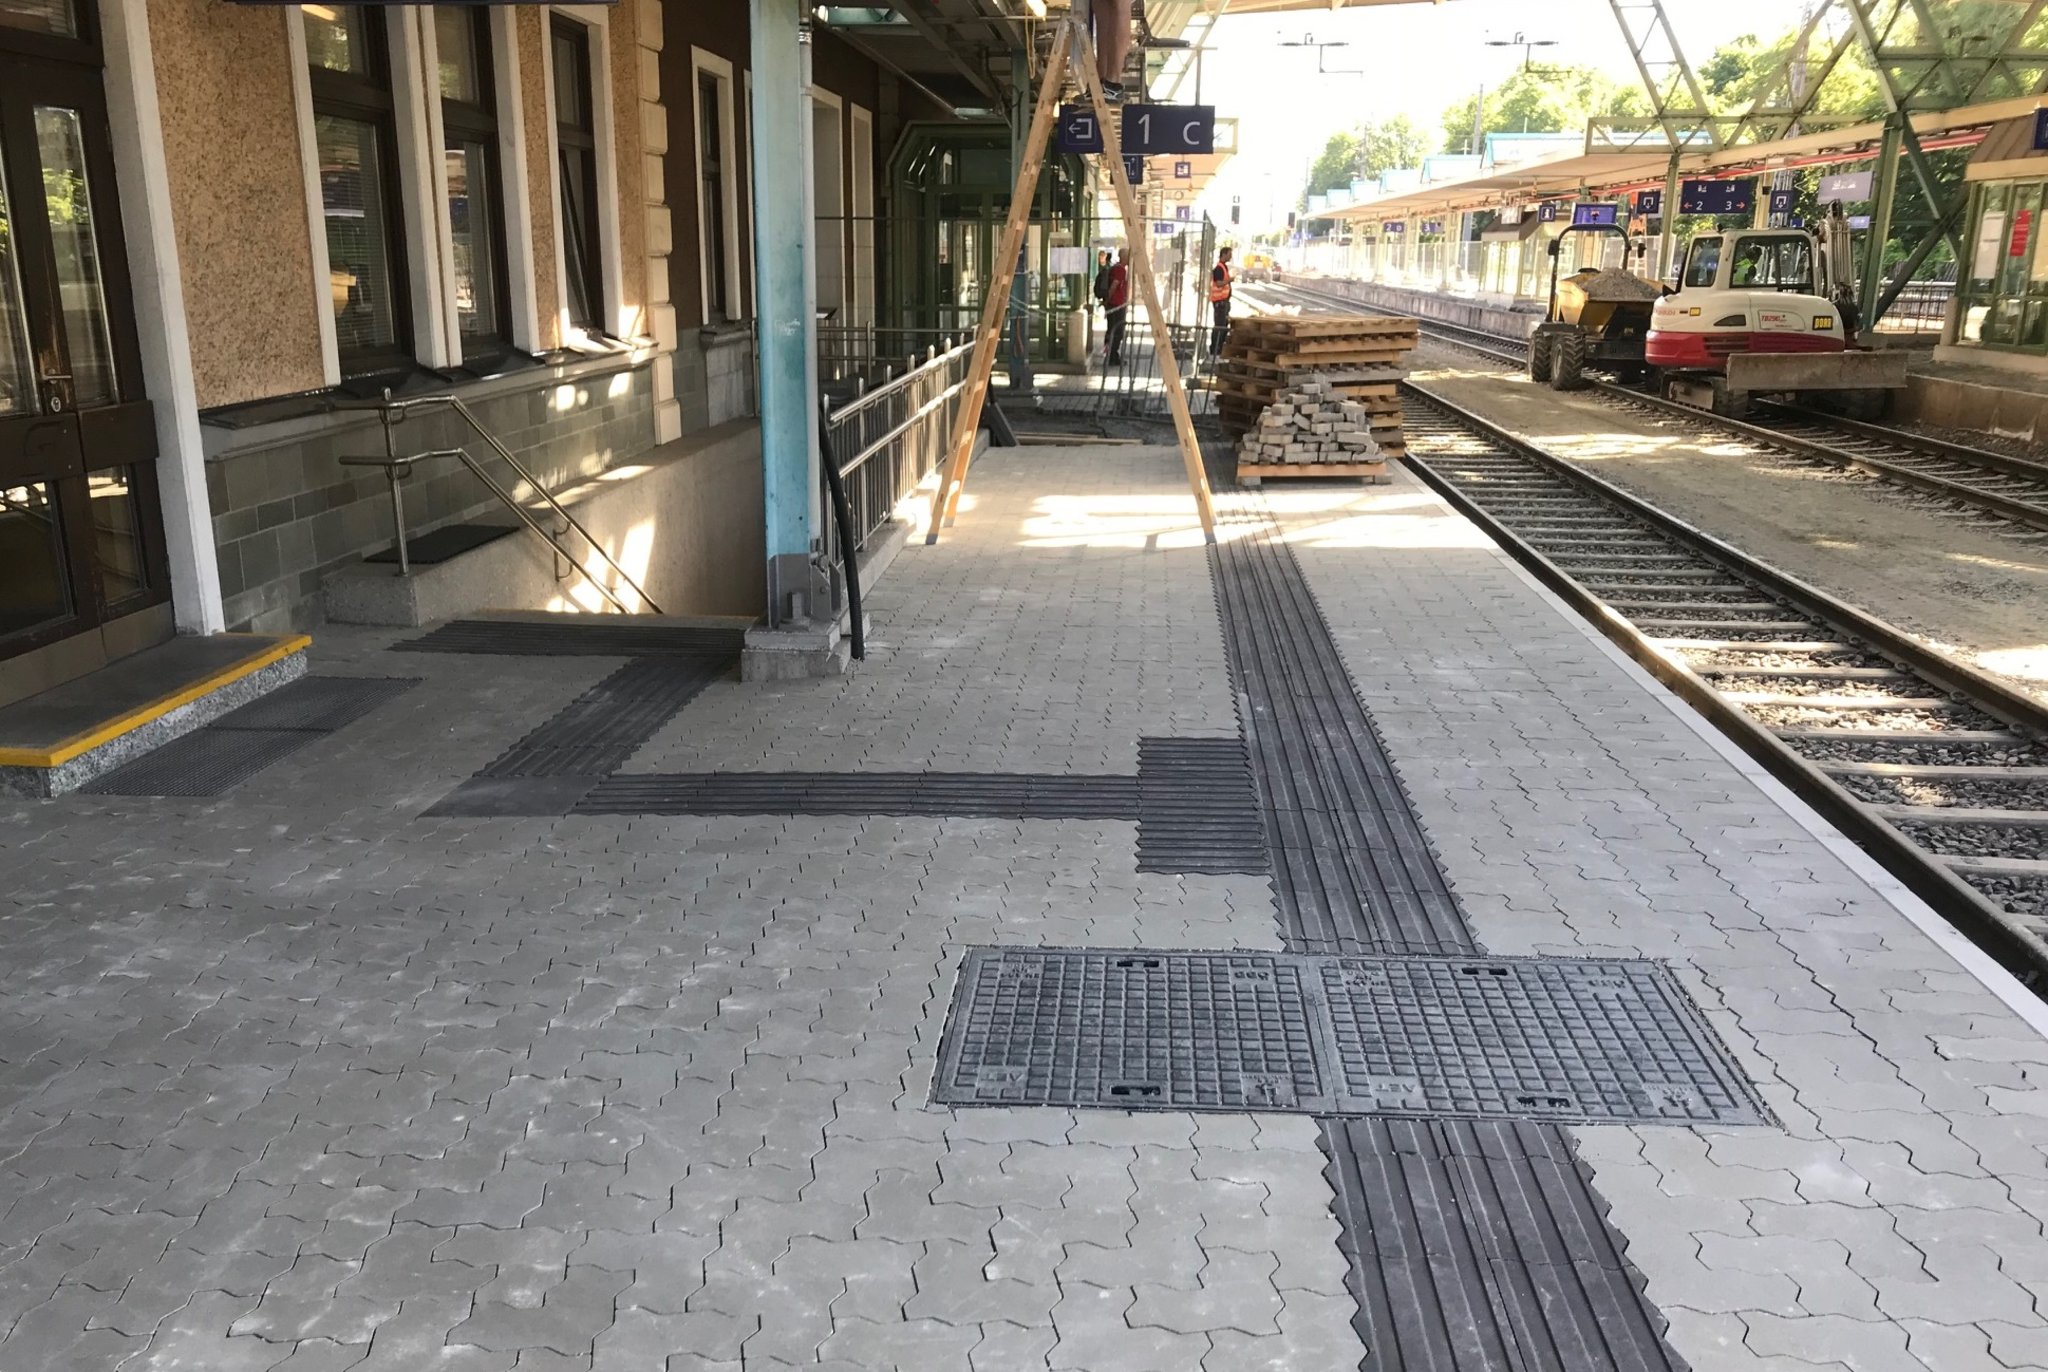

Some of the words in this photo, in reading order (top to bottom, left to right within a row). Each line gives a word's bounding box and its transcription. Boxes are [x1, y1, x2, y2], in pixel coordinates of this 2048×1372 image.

[1138, 114, 1150, 145] 1
[1183, 121, 1201, 145] C
[1696, 201, 1703, 211] 2
[1725, 201, 1732, 211] 3
